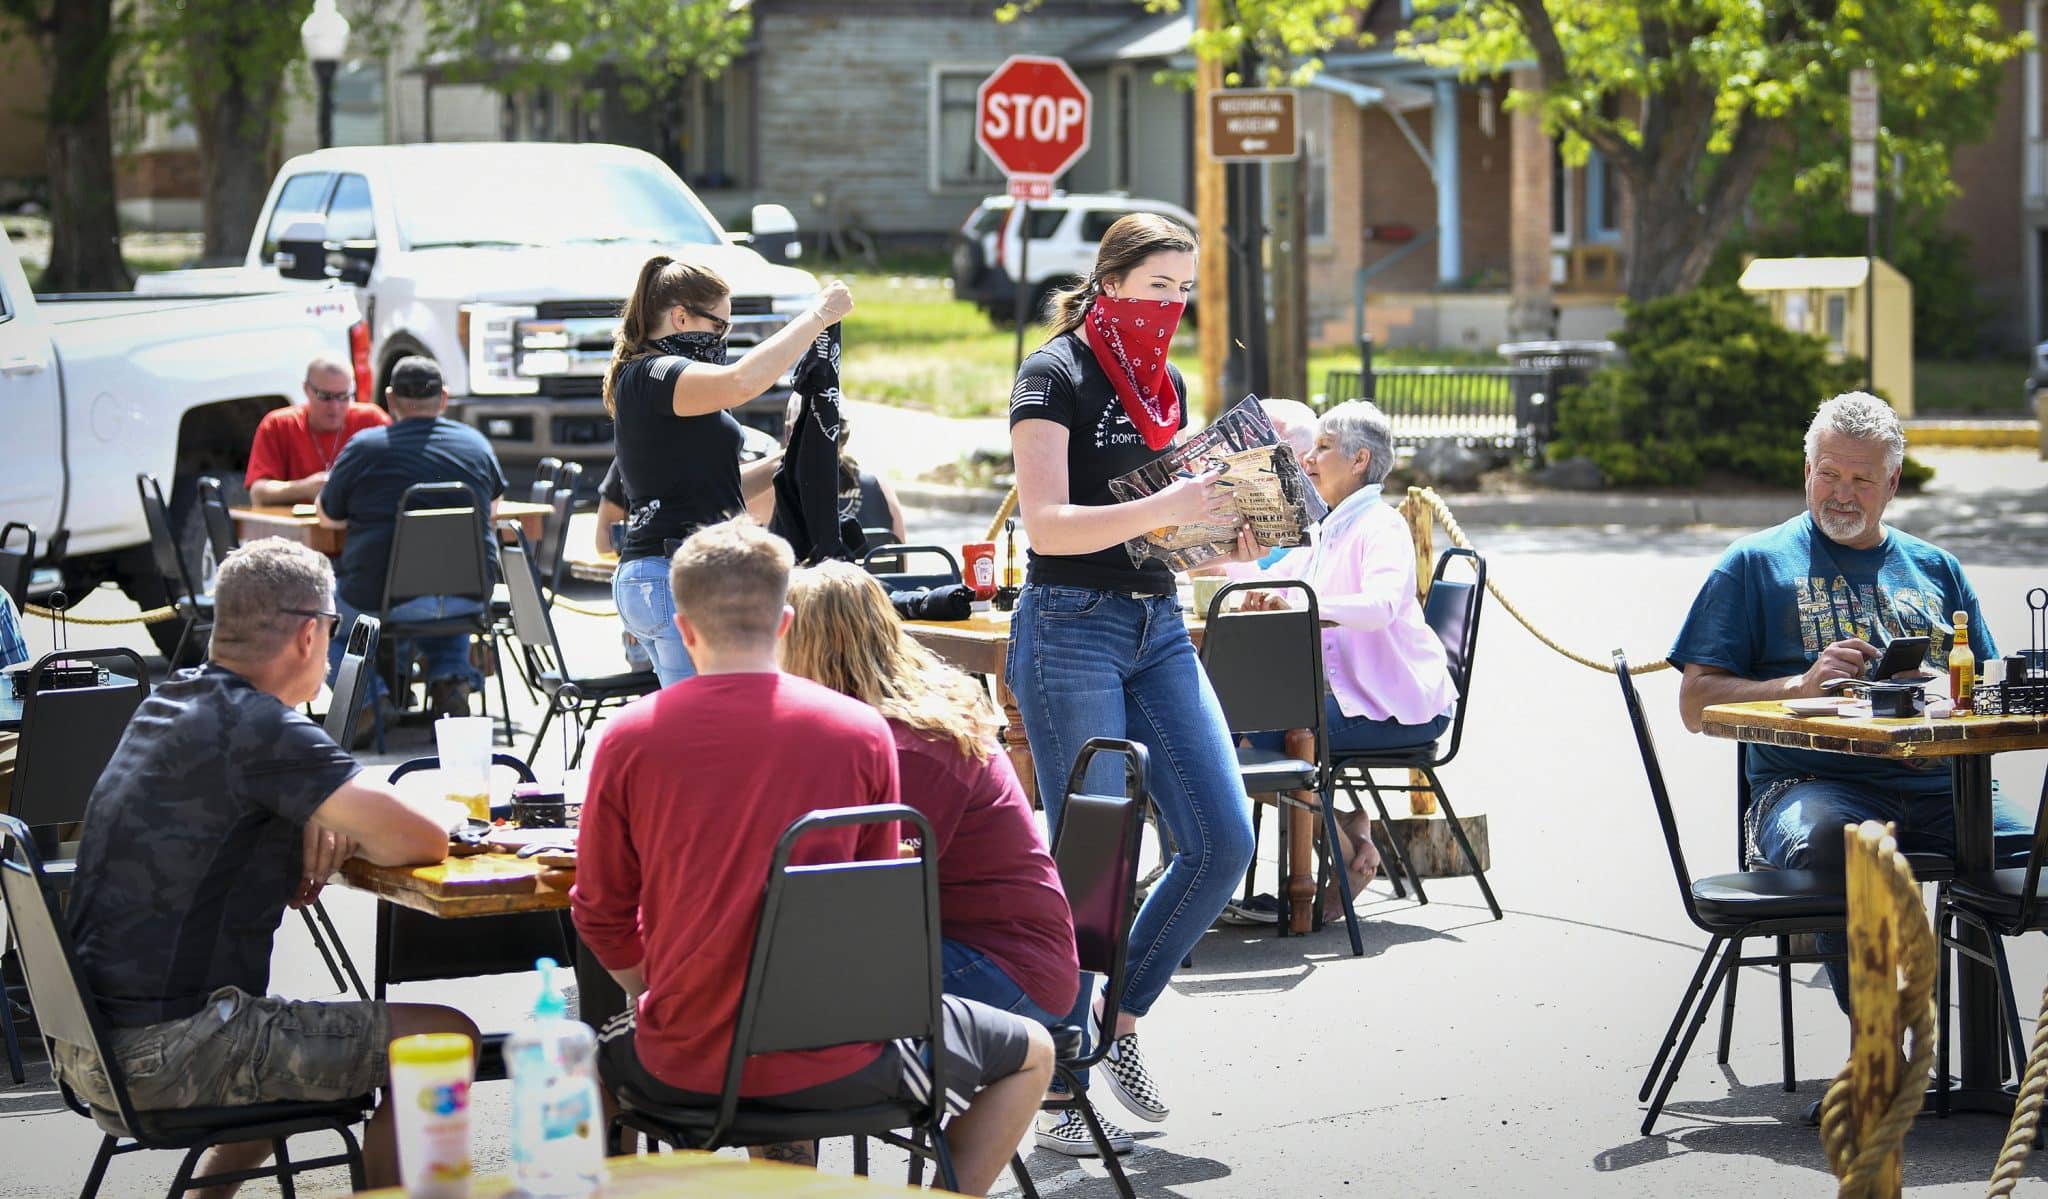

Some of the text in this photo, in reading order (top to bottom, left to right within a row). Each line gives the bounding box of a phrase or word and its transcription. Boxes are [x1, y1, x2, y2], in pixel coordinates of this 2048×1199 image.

[1219, 97, 1283, 113] HISTORICAL
[985, 92, 1082, 143] STOP
[1227, 117, 1278, 134] MUSEUM
[1111, 433, 1137, 445] DON'T
